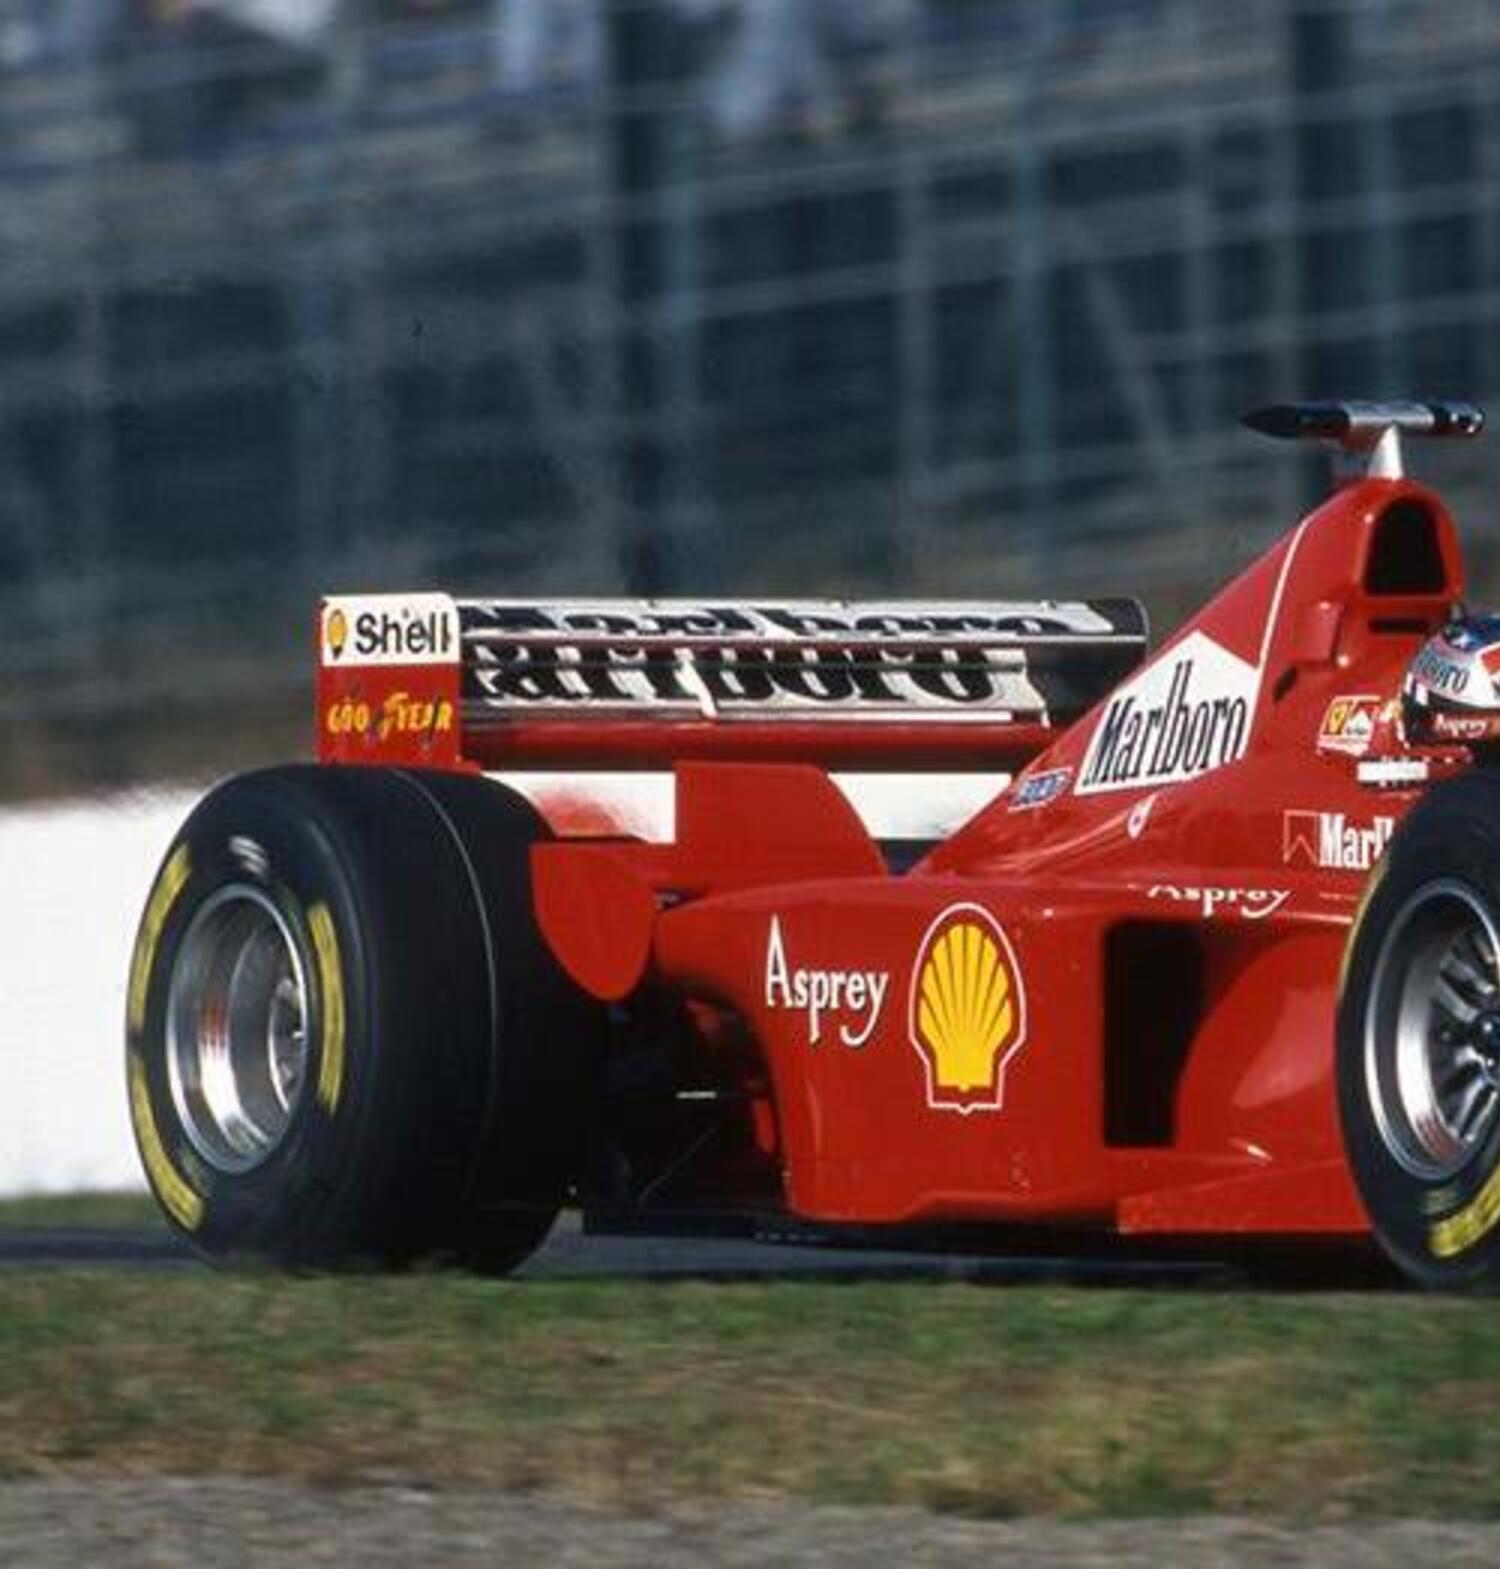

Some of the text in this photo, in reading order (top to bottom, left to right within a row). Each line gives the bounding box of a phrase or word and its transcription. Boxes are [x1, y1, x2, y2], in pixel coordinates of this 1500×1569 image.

[354, 612, 450, 656] Shell
[1082, 660, 1247, 787] Marlboro
[1319, 812, 1395, 871] Marl
[765, 912, 890, 1046] Asprey
